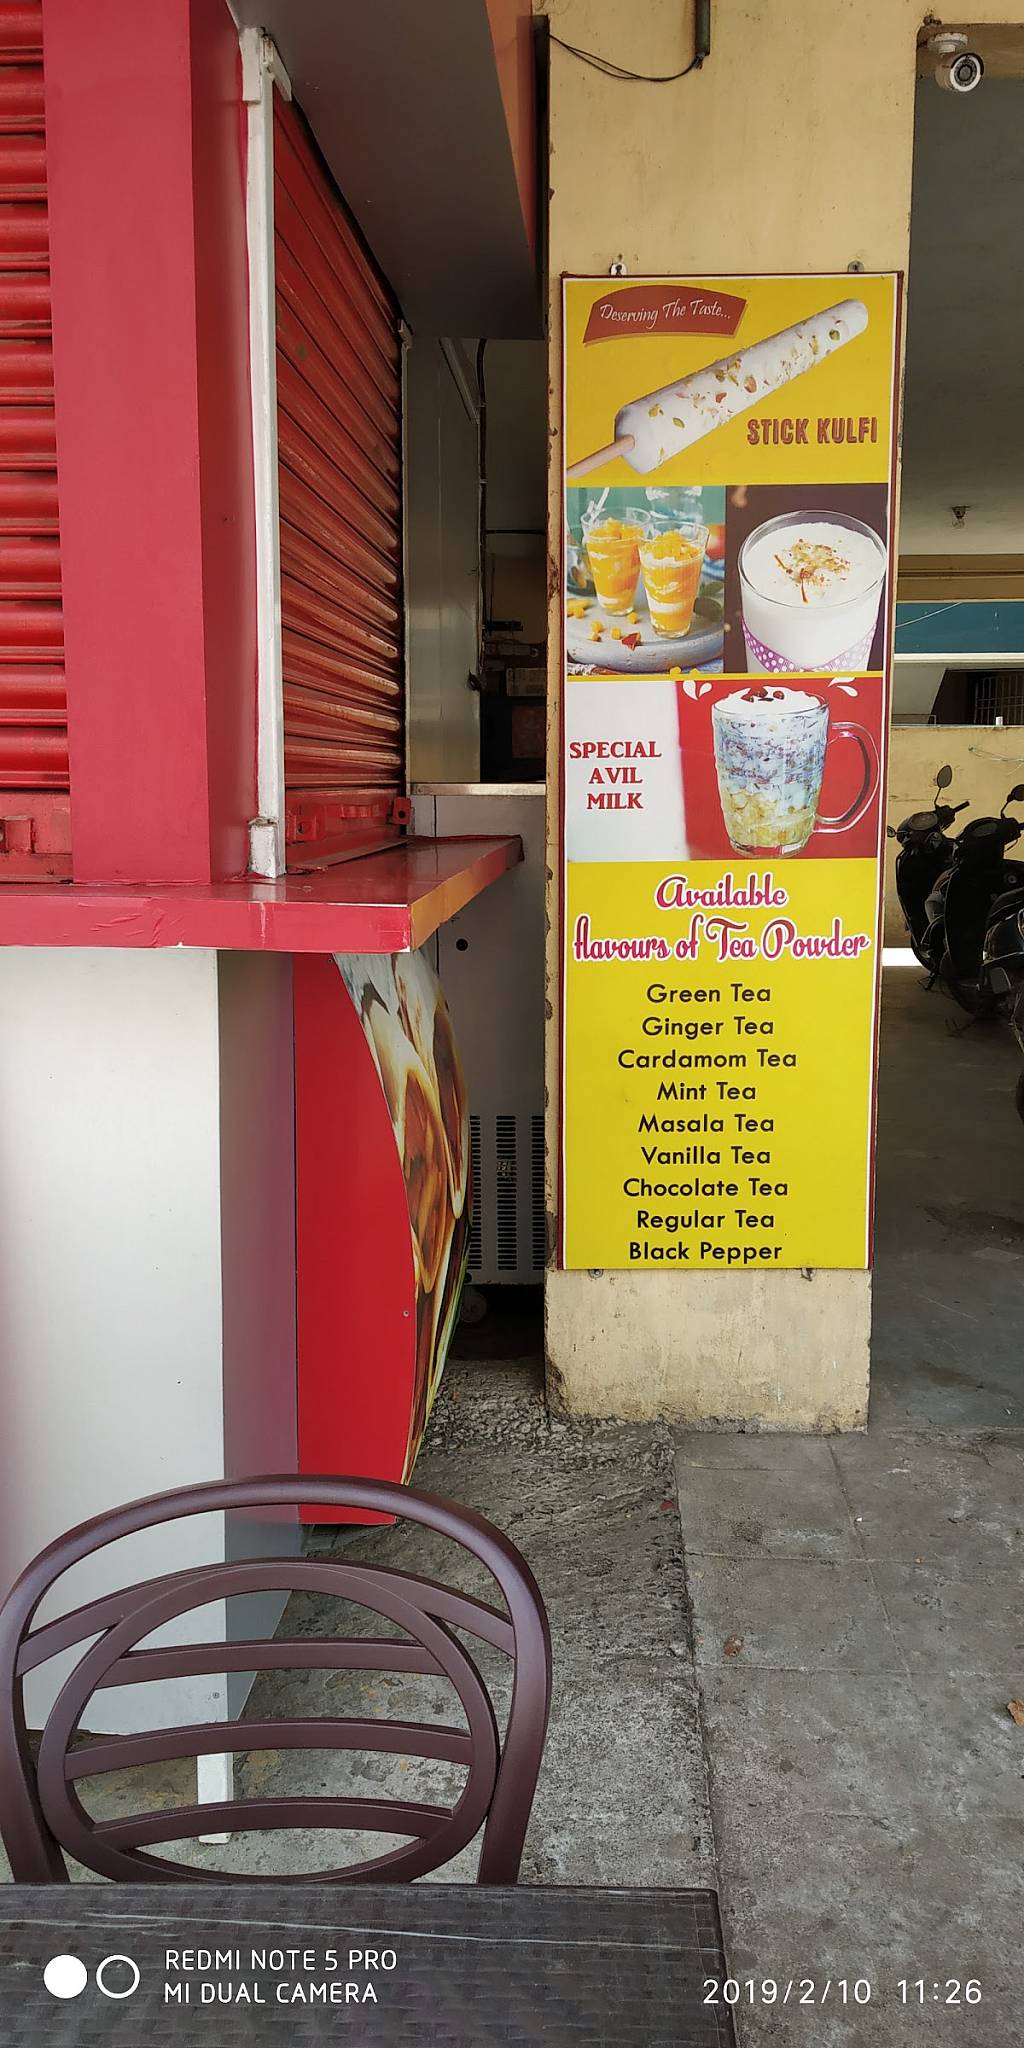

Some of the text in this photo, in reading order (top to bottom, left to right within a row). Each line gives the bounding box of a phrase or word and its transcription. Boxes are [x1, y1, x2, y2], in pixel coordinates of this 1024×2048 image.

[600, 298, 731, 330] Deserving The Taste...
[747, 416, 878, 445] STICK KULFI
[569, 741, 662, 759] SPECIAL
[588, 767, 643, 784] AVIL
[586, 793, 644, 810] MILK
[656, 873, 787, 908] Available
[574, 914, 870, 961] flavours of Tea Powder
[646, 984, 771, 1003] Green Tea
[642, 1016, 774, 1040] Ginger Tea
[618, 1049, 797, 1068] Cardamom Tea
[656, 1081, 756, 1100] Mint Tea
[638, 1114, 774, 1132] Masala Tea
[641, 1146, 770, 1164] Vanilla Tea
[623, 1178, 788, 1197] Chocolate Tea
[637, 1210, 774, 1232] Regular Tea
[629, 1242, 782, 1264] Black Pepper
